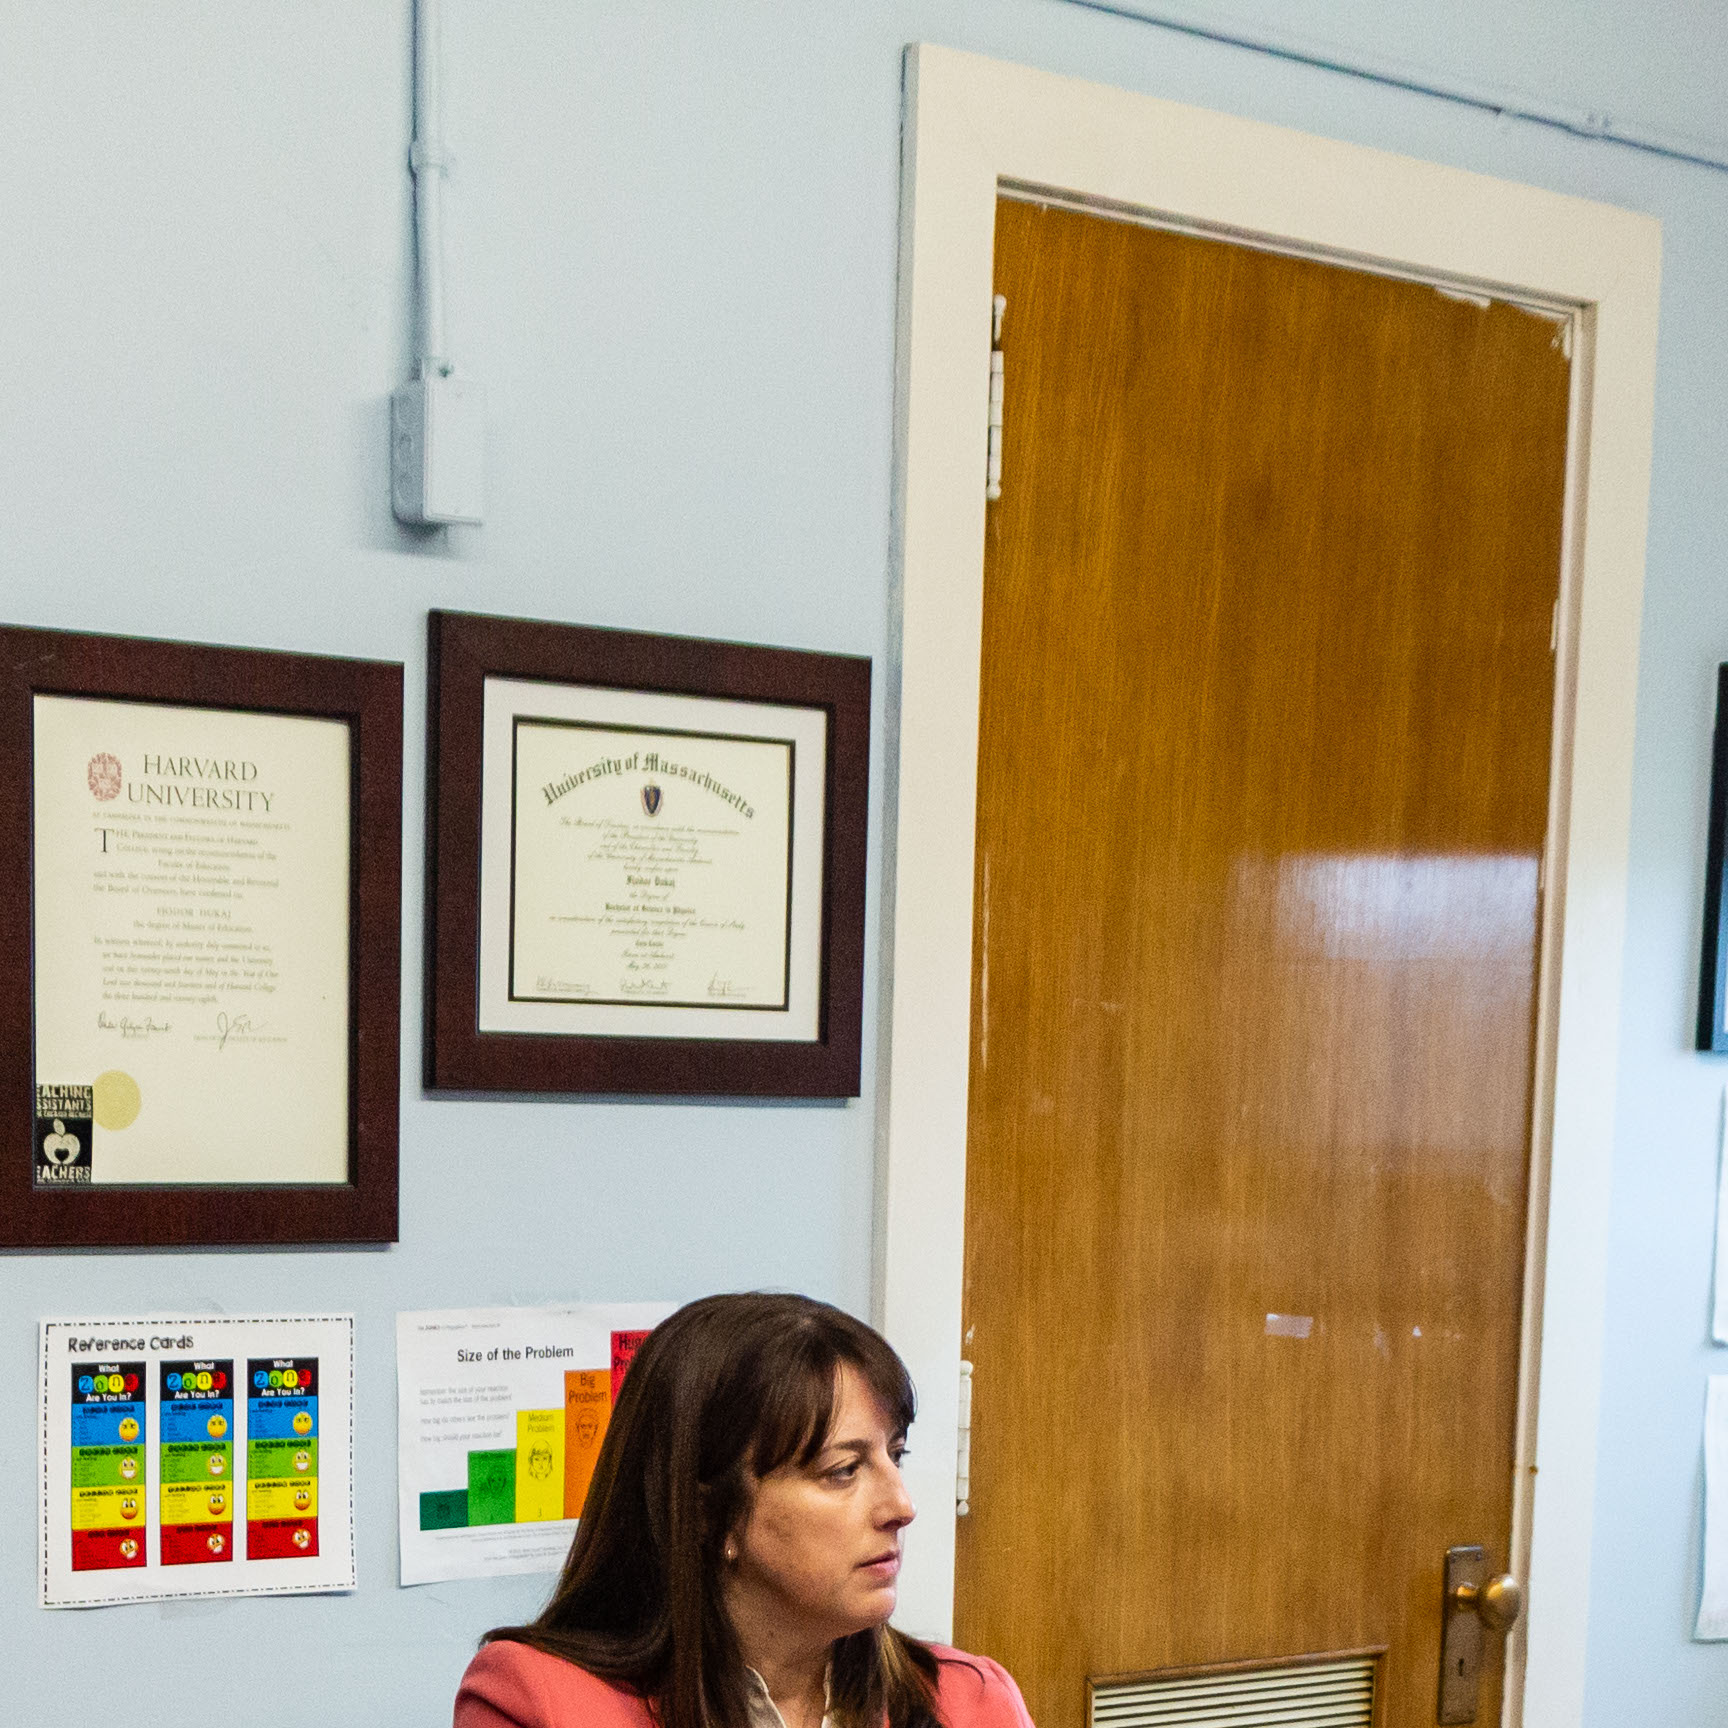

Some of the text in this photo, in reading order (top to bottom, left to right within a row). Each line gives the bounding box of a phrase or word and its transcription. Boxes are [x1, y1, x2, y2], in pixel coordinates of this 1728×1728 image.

[143, 754, 258, 781] HARVARD
[540, 752, 755, 820] University of Massachusetts
[127, 782, 275, 812] UNIVERSITY
[68, 1334, 194, 1353] Reference Cards
[457, 1345, 574, 1362] Size of the Problem
[579, 1373, 595, 1389] Big
[568, 1390, 608, 1405] Problem
